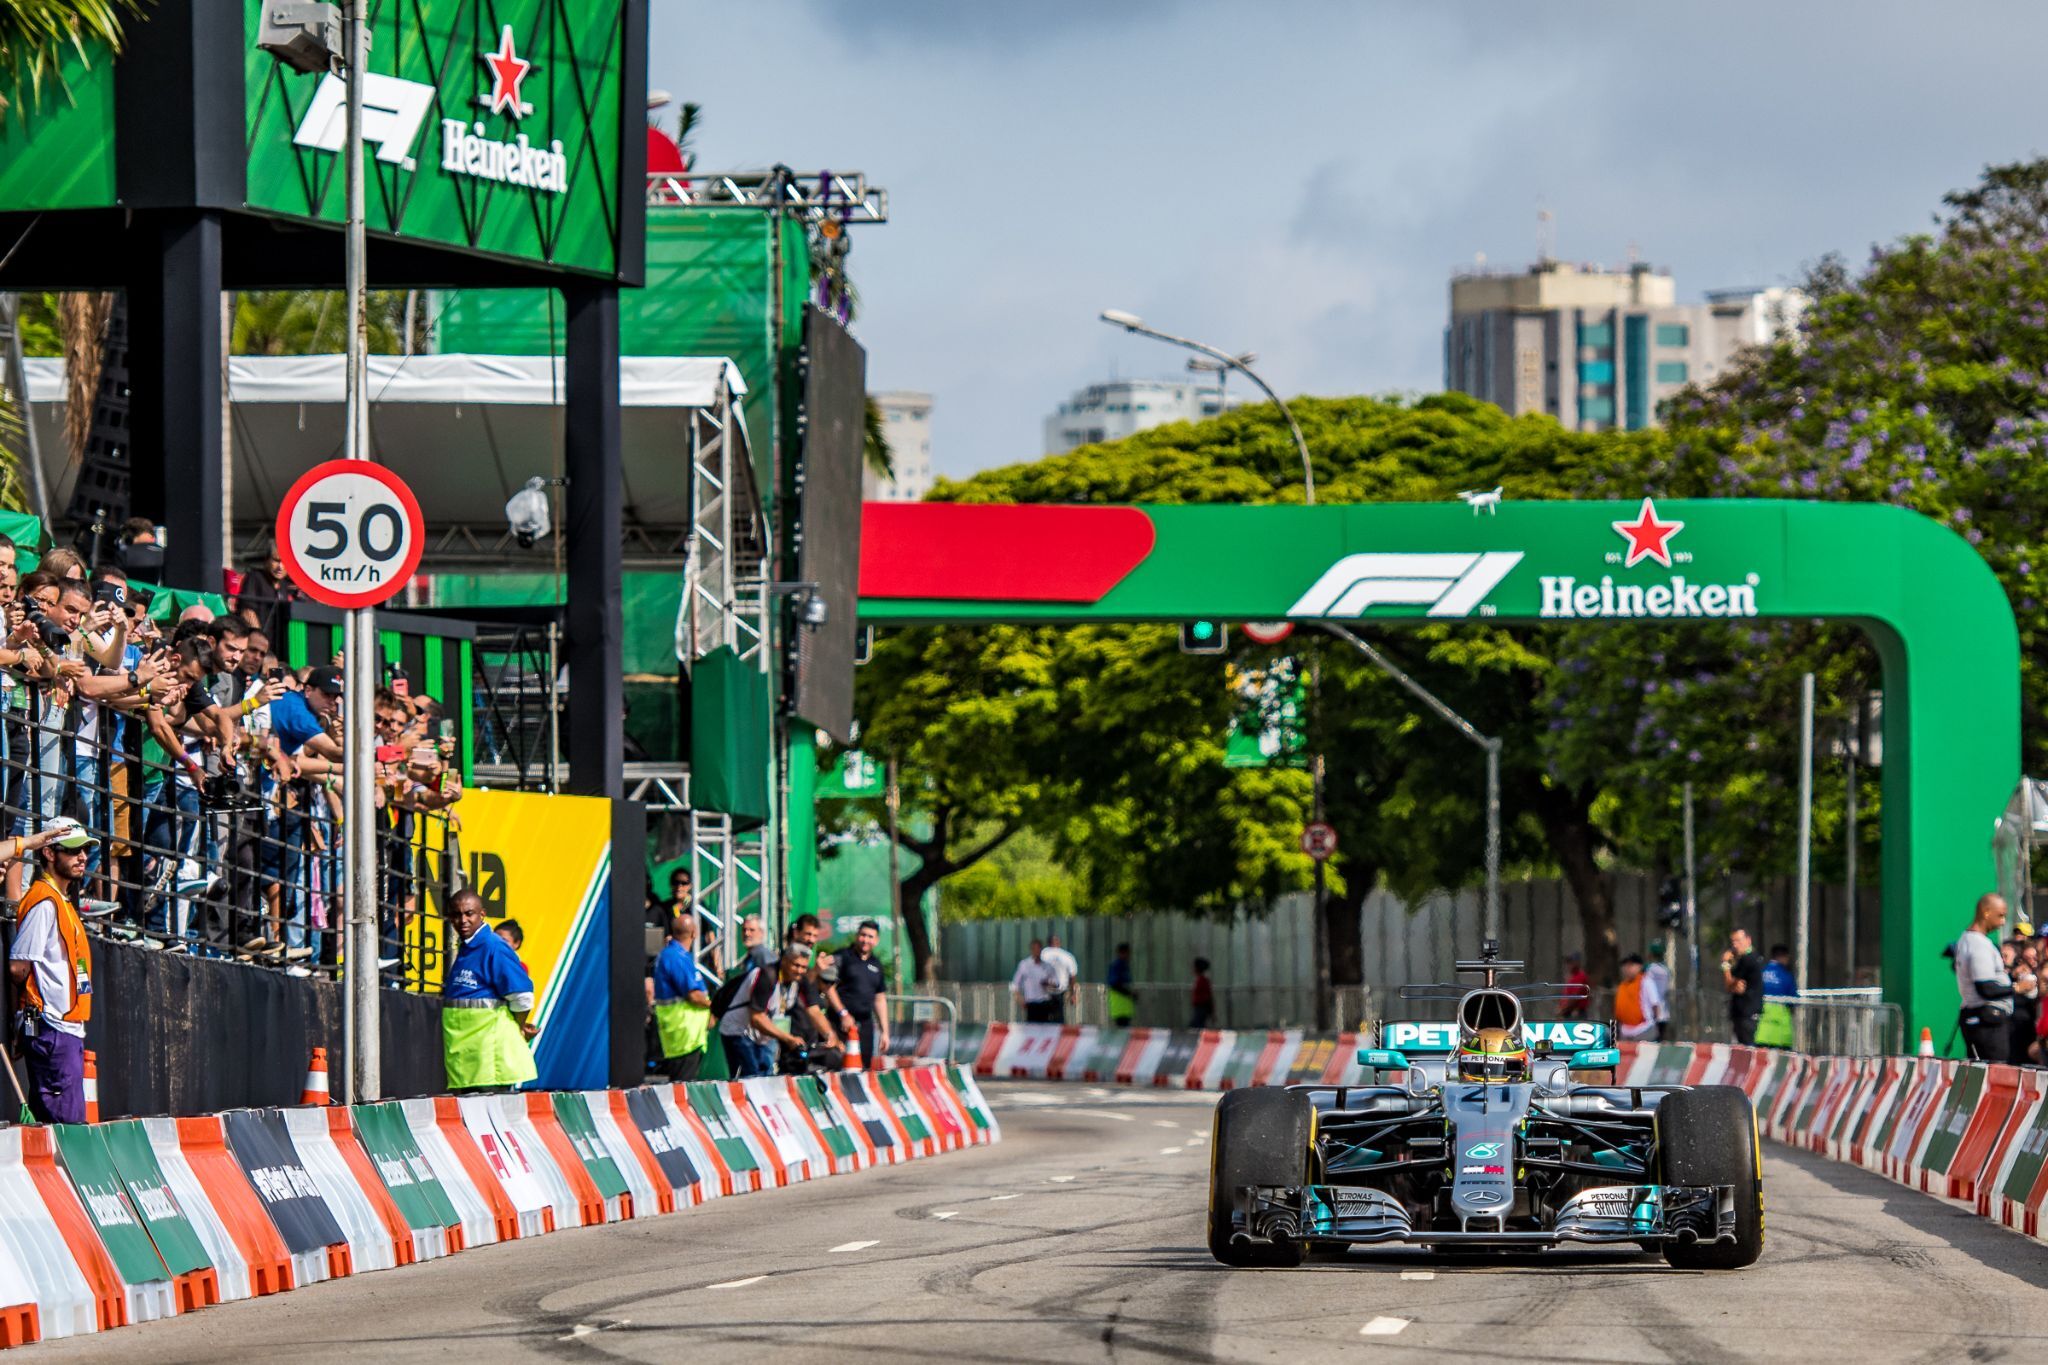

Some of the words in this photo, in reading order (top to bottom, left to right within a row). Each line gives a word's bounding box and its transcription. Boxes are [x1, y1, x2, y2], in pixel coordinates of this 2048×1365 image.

[441, 119, 567, 193] Heineken
[304, 502, 403, 562] 50
[321, 563, 380, 582] km/h
[1286, 551, 1525, 618] F1
[1540, 575, 1757, 618] Heineken
[1461, 1085, 1511, 1103] 21
